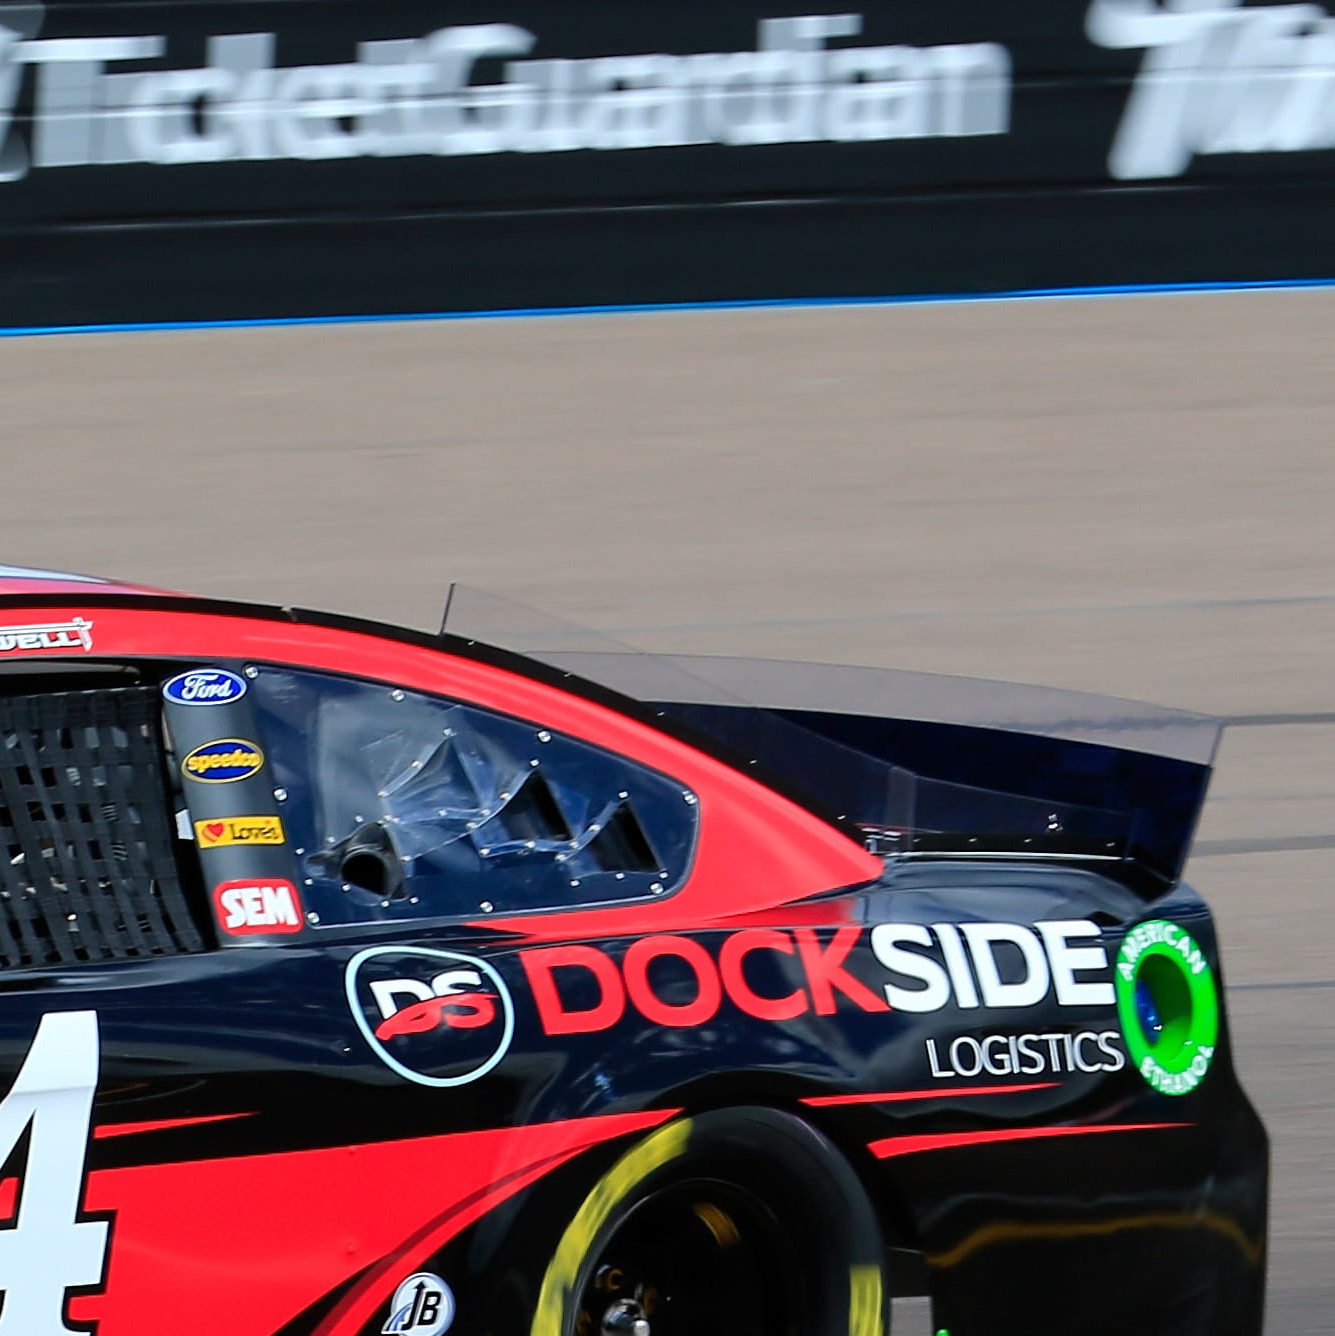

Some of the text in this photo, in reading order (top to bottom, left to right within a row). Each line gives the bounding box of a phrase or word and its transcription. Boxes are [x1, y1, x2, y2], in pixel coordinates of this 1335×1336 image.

[181, 674, 233, 699] Ford
[221, 886, 298, 928] SEM
[1116, 921, 1206, 982] AMERICAN
[518, 919, 1116, 1036] DOCKSIDE
[926, 1029, 1126, 1078] LOGISTICS
